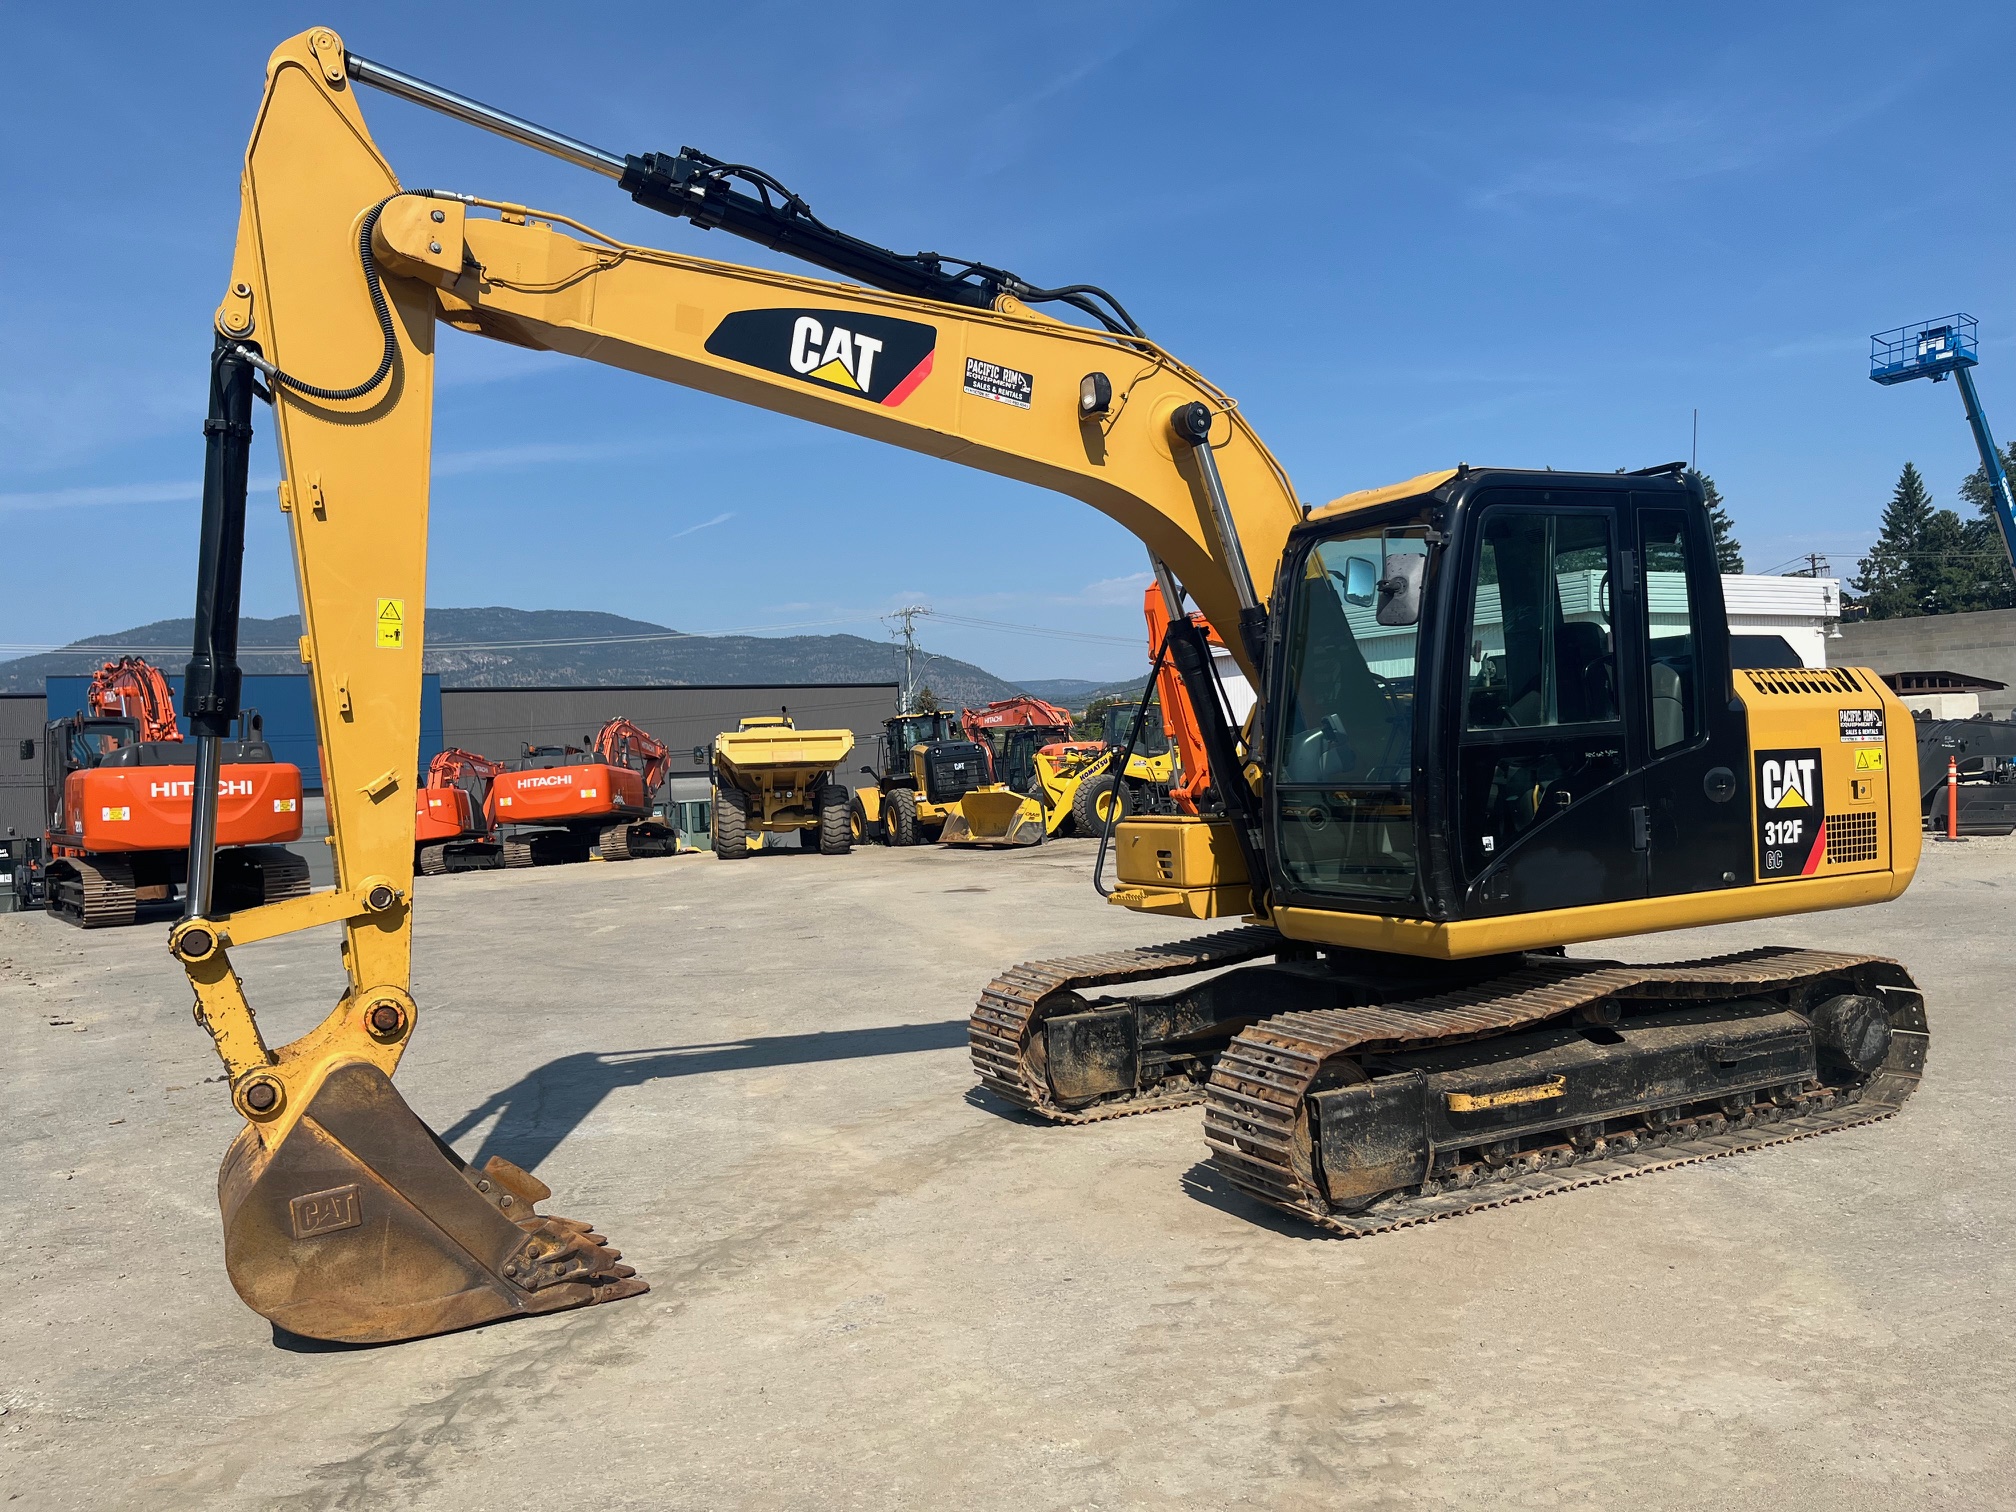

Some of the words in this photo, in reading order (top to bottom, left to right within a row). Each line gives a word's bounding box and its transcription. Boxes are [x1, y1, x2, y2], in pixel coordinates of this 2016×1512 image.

[789, 316, 882, 393] CAT
[966, 371, 1016, 389] EQUIPMENT
[967, 358, 1000, 379] PACIFIC
[1003, 368, 1018, 385] RIM
[972, 380, 991, 391] SALES
[998, 387, 1023, 400] RENTALS
[1840, 710, 1861, 722] PACIFIC
[954, 762, 964, 770] CAT
[1079, 758, 1109, 781] KOMATSU
[151, 780, 253, 798] HITCHI
[518, 775, 572, 789] HITACHI
[1762, 759, 1815, 809] CAT
[1764, 819, 1803, 846] 312F
[1766, 850, 1783, 869] GC
[300, 1194, 353, 1232] CAT
